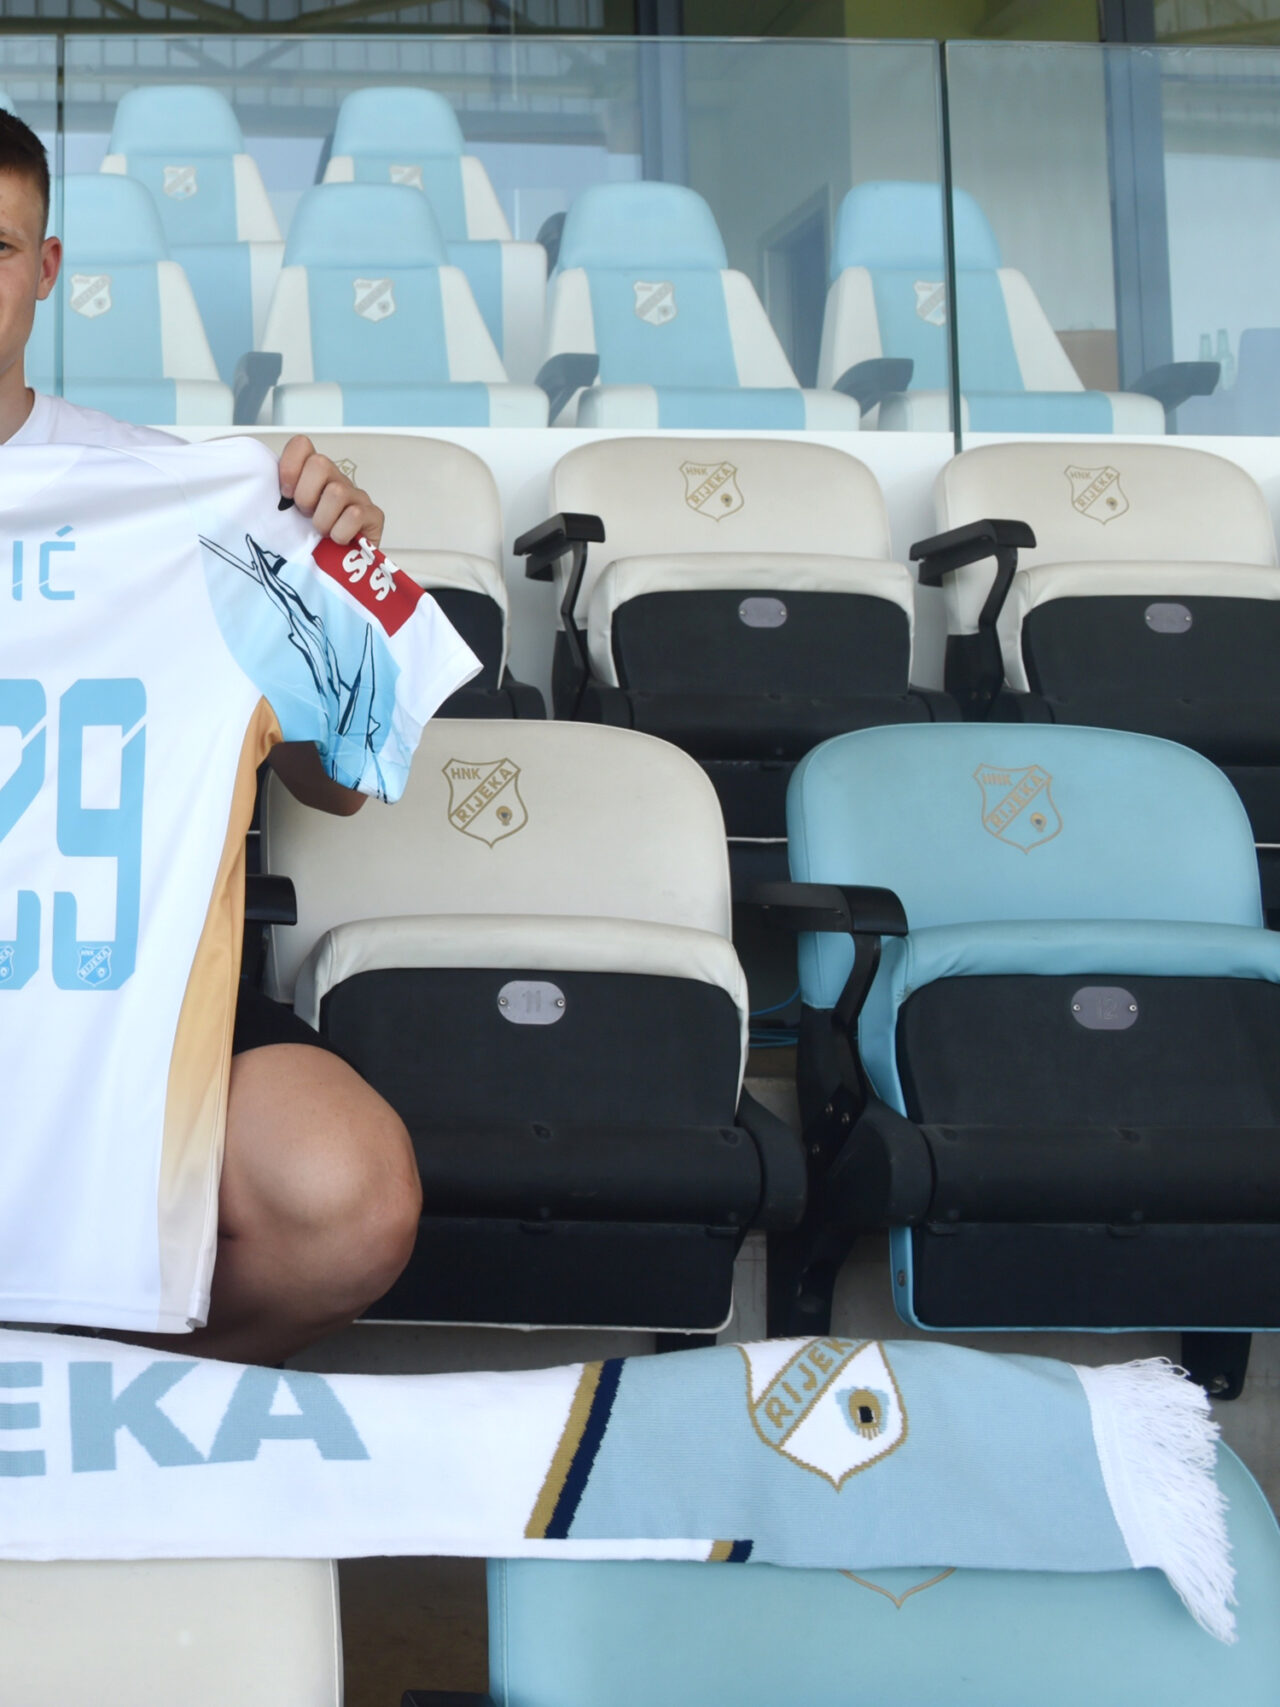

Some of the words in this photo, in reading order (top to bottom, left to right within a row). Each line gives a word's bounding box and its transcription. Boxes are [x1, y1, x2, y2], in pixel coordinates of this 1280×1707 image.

[450, 767, 482, 780] HNK
[455, 768, 513, 823] RIJEKA
[989, 775, 1044, 828] RIJEKA
[764, 1337, 855, 1429] RIJEK
